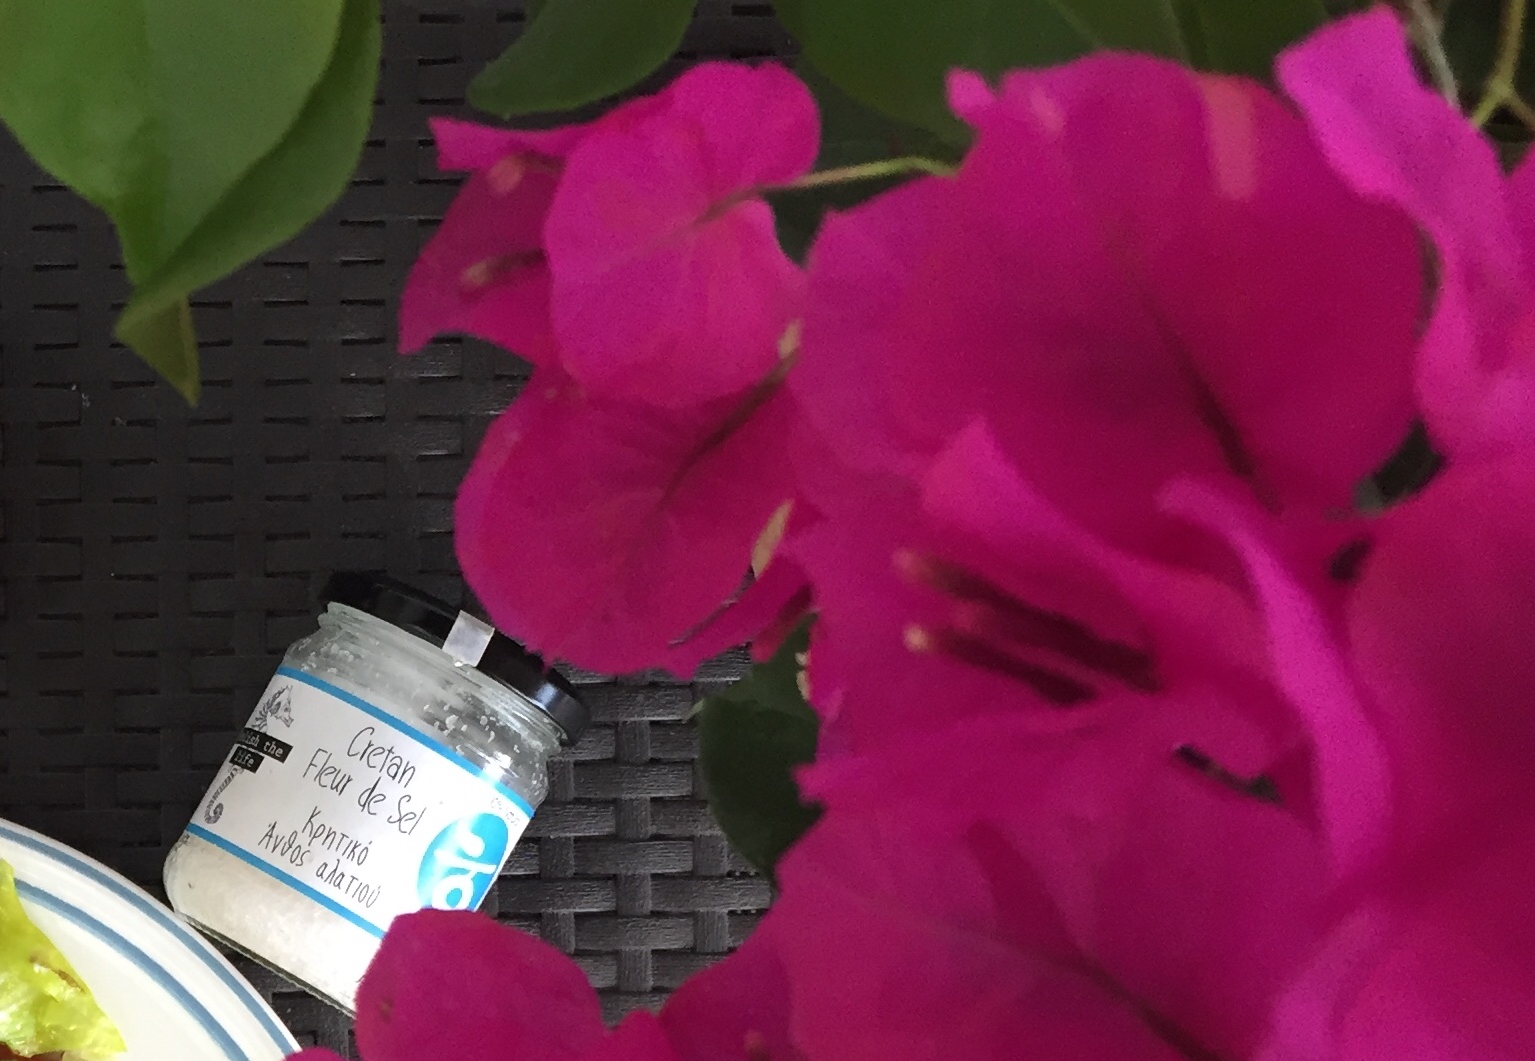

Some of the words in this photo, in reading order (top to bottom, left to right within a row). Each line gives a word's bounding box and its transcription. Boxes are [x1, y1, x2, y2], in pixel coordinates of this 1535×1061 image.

[264, 741, 284, 758] the
[347, 726, 416, 788] Cretan
[303, 748, 354, 796] Fleur
[358, 776, 387, 816] de
[387, 794, 427, 836] Sel
